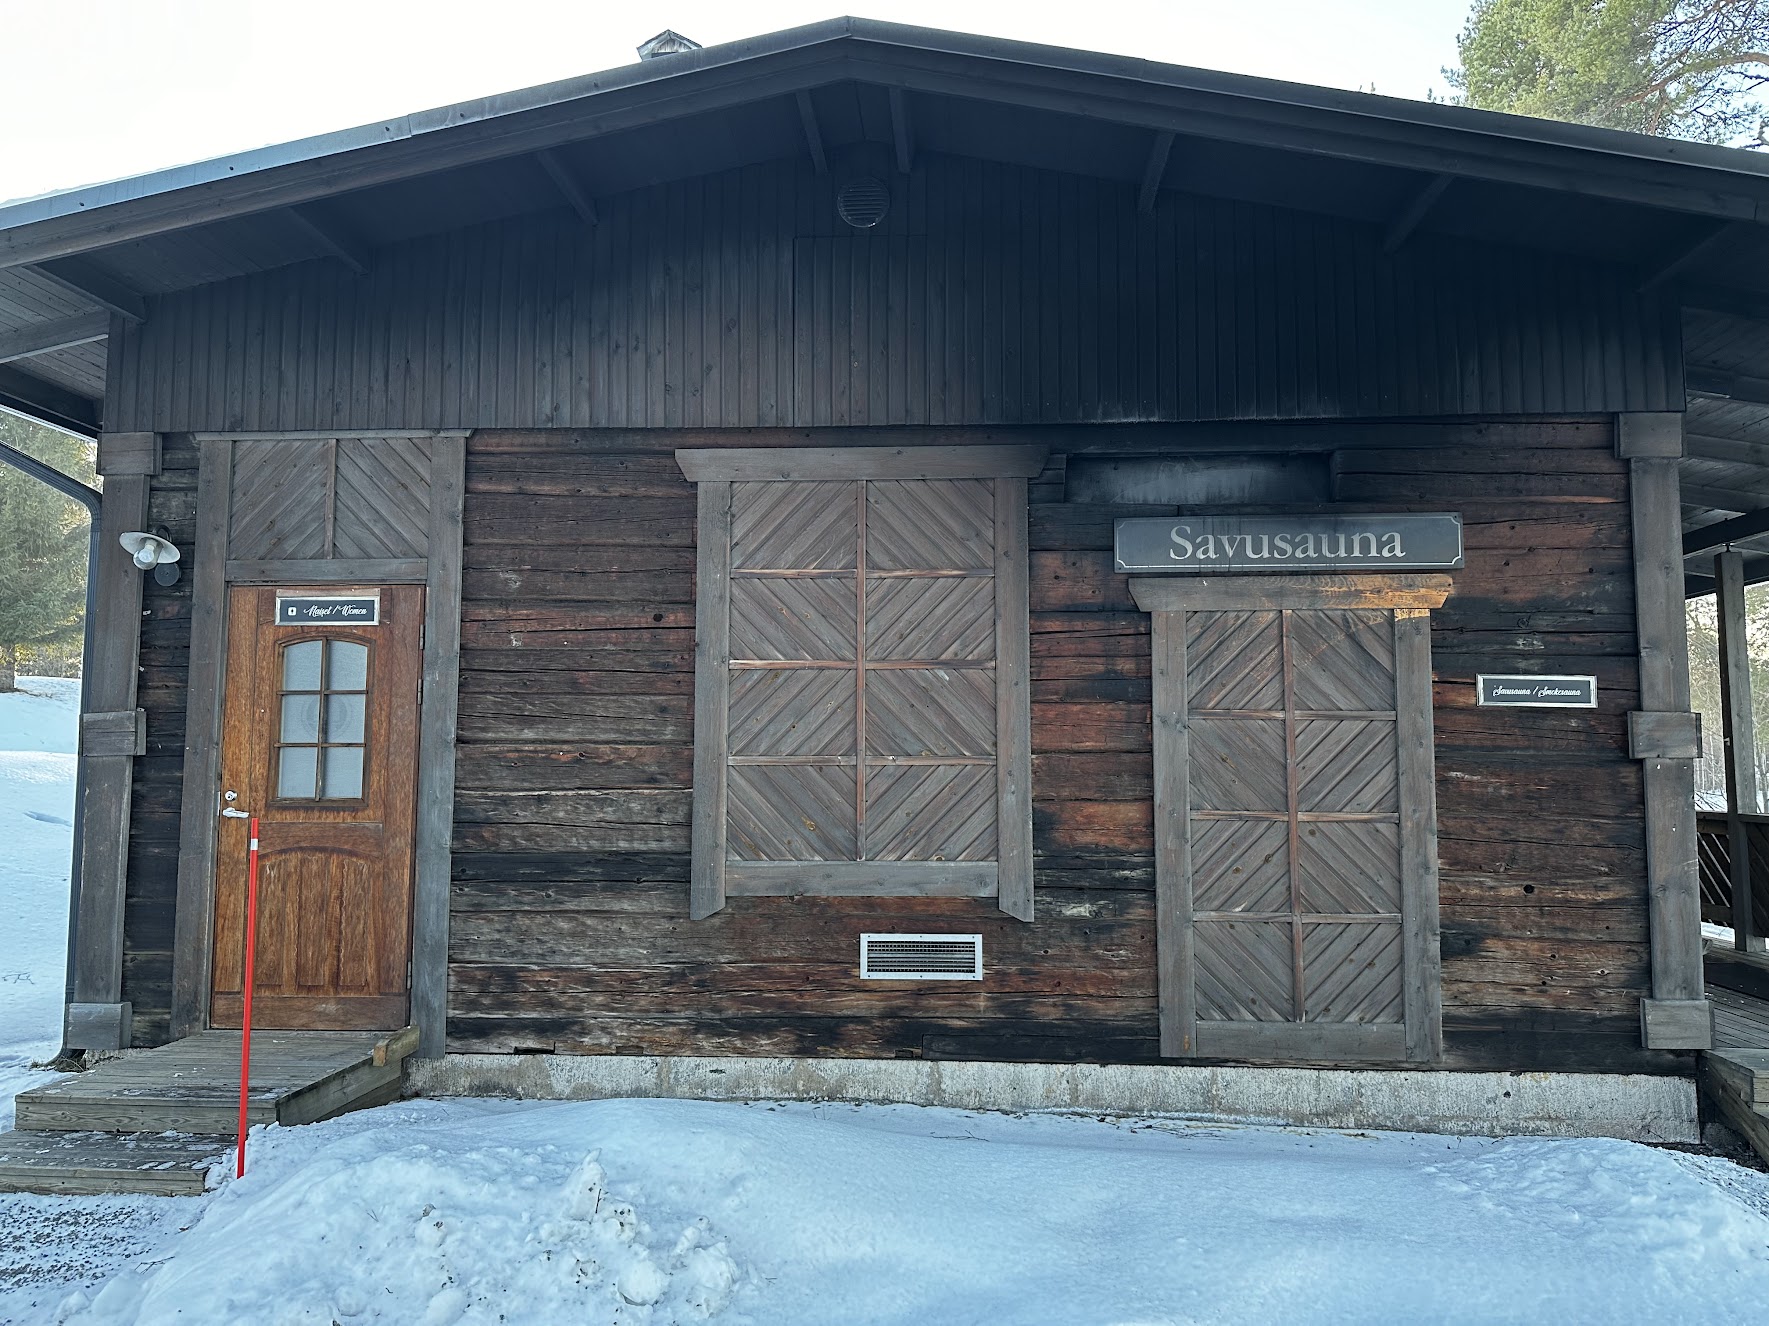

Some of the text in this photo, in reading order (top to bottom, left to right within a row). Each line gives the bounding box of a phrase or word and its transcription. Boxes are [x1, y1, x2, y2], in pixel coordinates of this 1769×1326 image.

[1169, 525, 1406, 560] Savusauna
[338, 604, 368, 617] Women
[1492, 685, 1531, 697] Savusauna
[1538, 686, 1582, 698] Smokesauna
